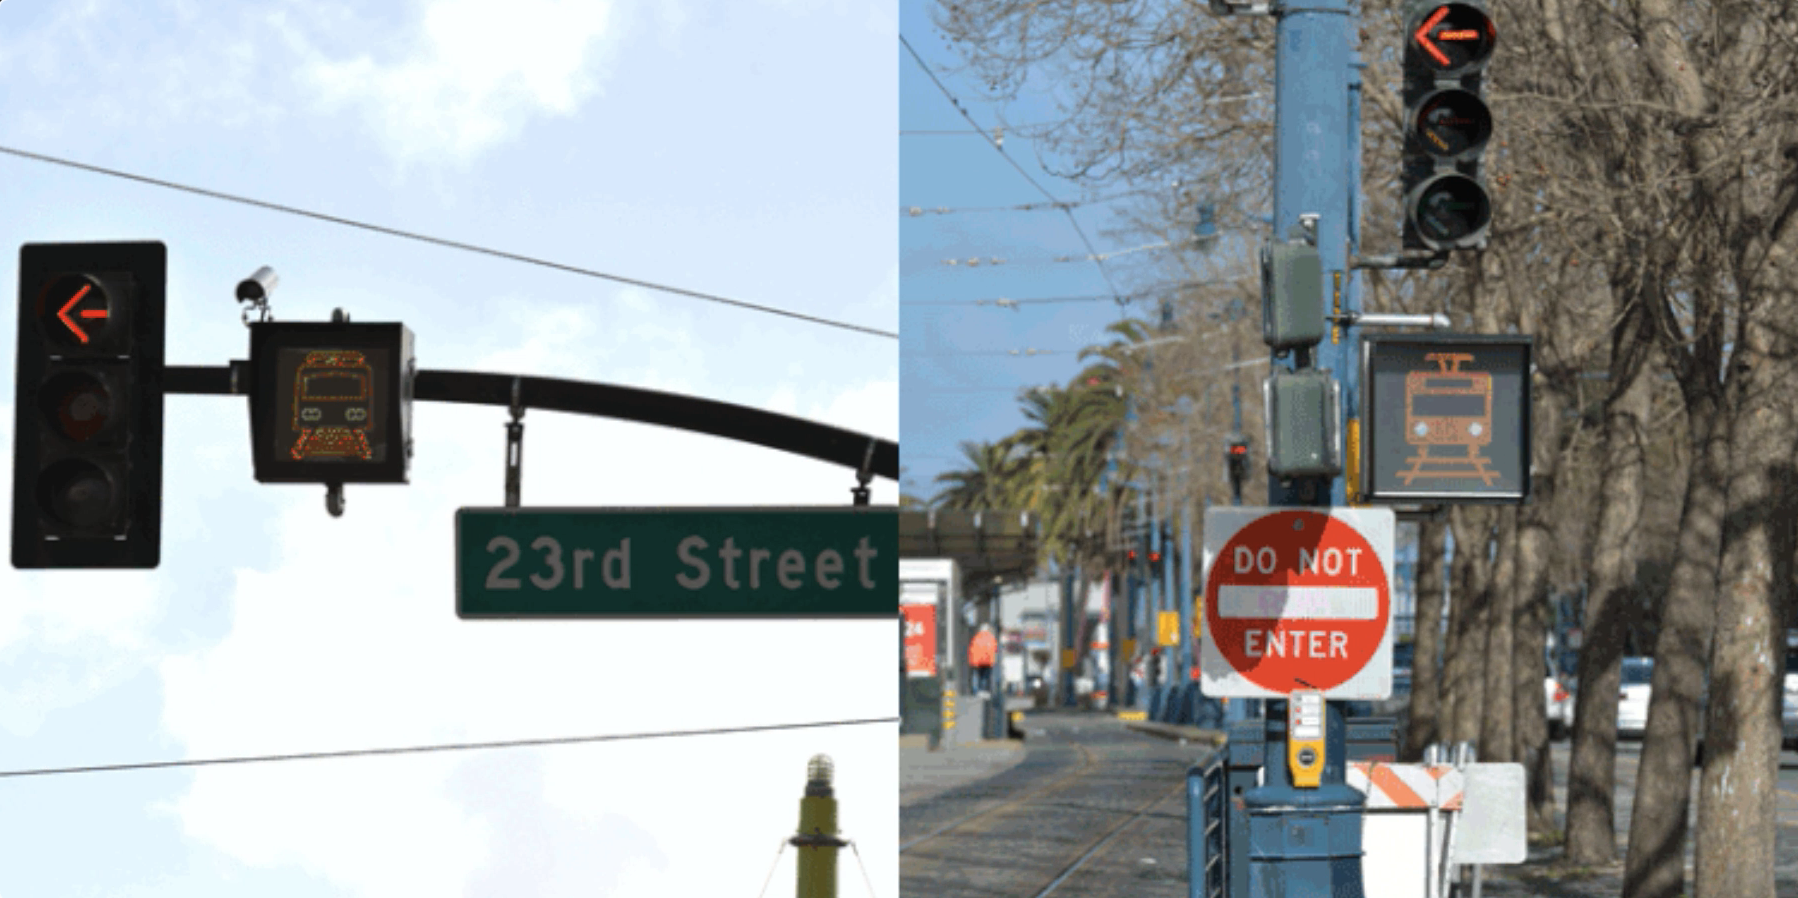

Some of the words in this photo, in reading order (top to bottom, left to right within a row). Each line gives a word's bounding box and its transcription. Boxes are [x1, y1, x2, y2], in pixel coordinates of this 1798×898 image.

[485, 535, 632, 590] 23rd
[675, 535, 879, 590] Street
[1233, 546, 1277, 575] DO
[1299, 547, 1362, 576] NOT
[1244, 629, 1348, 659] ENTER
